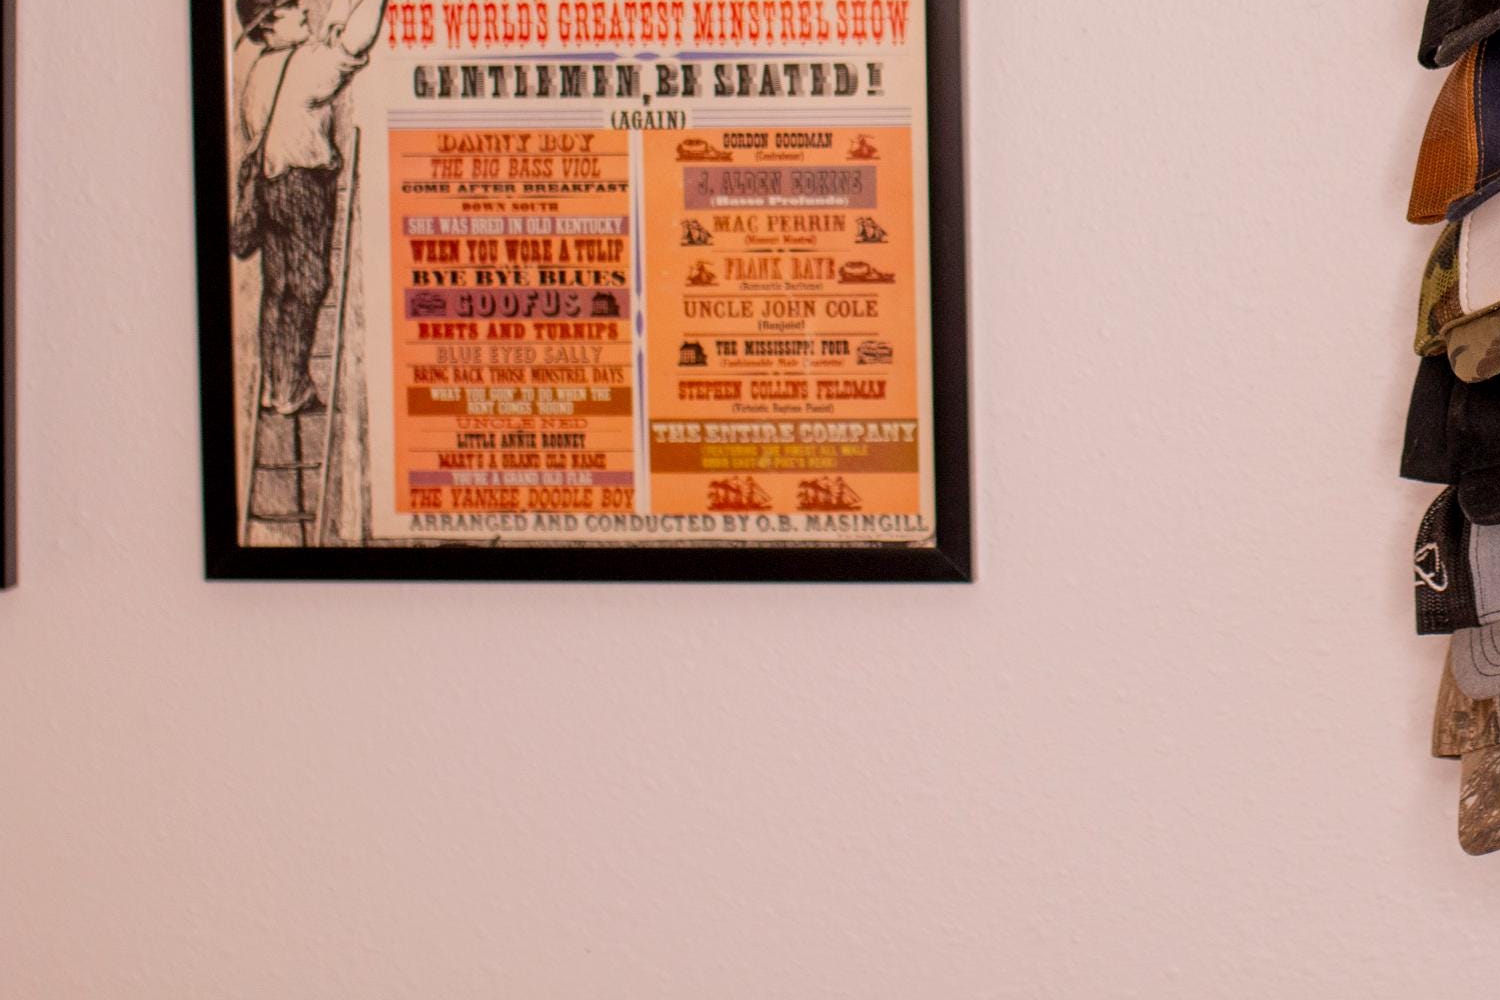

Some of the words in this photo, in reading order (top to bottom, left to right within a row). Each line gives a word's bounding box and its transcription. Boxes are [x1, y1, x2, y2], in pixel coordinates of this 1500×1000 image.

[655, 63, 702, 97] BE
[610, 109, 687, 130] (AGAIN)
[438, 133, 532, 153] DANNY
[538, 133, 595, 153] BOY
[722, 132, 769, 149] GORDON
[775, 132, 833, 149] GOODMAN
[430, 158, 464, 179] THE
[471, 158, 500, 179] BIG
[508, 158, 554, 179] BASS
[561, 158, 602, 179] VIOL
[402, 183, 450, 194] COME
[457, 183, 516, 194] AFTER
[523, 183, 630, 194] BREAKFAST
[722, 170, 782, 195] ALDEN
[462, 202, 505, 212] DOWN
[512, 202, 559, 212] SOUTH
[408, 217, 435, 235] SHE
[438, 217, 468, 235] WAS
[508, 217, 523, 235] IN
[527, 217, 552, 235] OLD
[556, 217, 624, 235] KENTUCKY
[713, 214, 760, 233] MAC
[766, 214, 847, 233] PERRIN
[410, 239, 460, 262] WHEN
[466, 239, 499, 262] YOU
[504, 239, 553, 262] WORE
[558, 239, 570, 262] A
[574, 239, 625, 262] TULIP
[412, 269, 466, 286] BYE
[475, 269, 531, 286] BYE
[538, 269, 626, 286] BLUES
[724, 257, 784, 281] FRANK
[456, 290, 582, 318] GOOFUS
[683, 300, 754, 319] UNCLE
[761, 300, 817, 319] JOHN
[825, 300, 879, 319] COLE
[418, 322, 479, 340] BEETS
[486, 322, 526, 340] AND
[534, 322, 619, 340] TURNIPS
[437, 346, 482, 364] BLUE
[489, 346, 537, 364] EYED
[544, 346, 604, 364] SALLY
[715, 340, 738, 356] THE
[821, 340, 850, 356] FOUR
[454, 367, 485, 384] BACK
[531, 367, 588, 384] MINSTREL
[593, 367, 625, 384] DAYS
[678, 380, 743, 400] STEPHEN
[750, 380, 809, 400] COLLINS
[816, 380, 887, 400] FELDMAN
[456, 418, 531, 430] UNCLE
[540, 418, 588, 430] NED
[651, 423, 701, 444] THE
[703, 423, 795, 444] ENTIRE
[800, 423, 918, 444] COMPANY
[457, 433, 497, 449] LITTLE
[501, 433, 537, 449] ANNIE
[542, 433, 586, 449] ROONEY
[410, 488, 442, 509] THE
[453, 488, 520, 509] YANKEE
[528, 488, 594, 509] DOODLE
[601, 488, 635, 509] BOY
[409, 514, 528, 532] ARRANGED
[532, 514, 578, 532] AND
[584, 514, 721, 532] CONDUCTED
[723, 514, 751, 532] BY
[804, 514, 929, 532] MASINGILL
